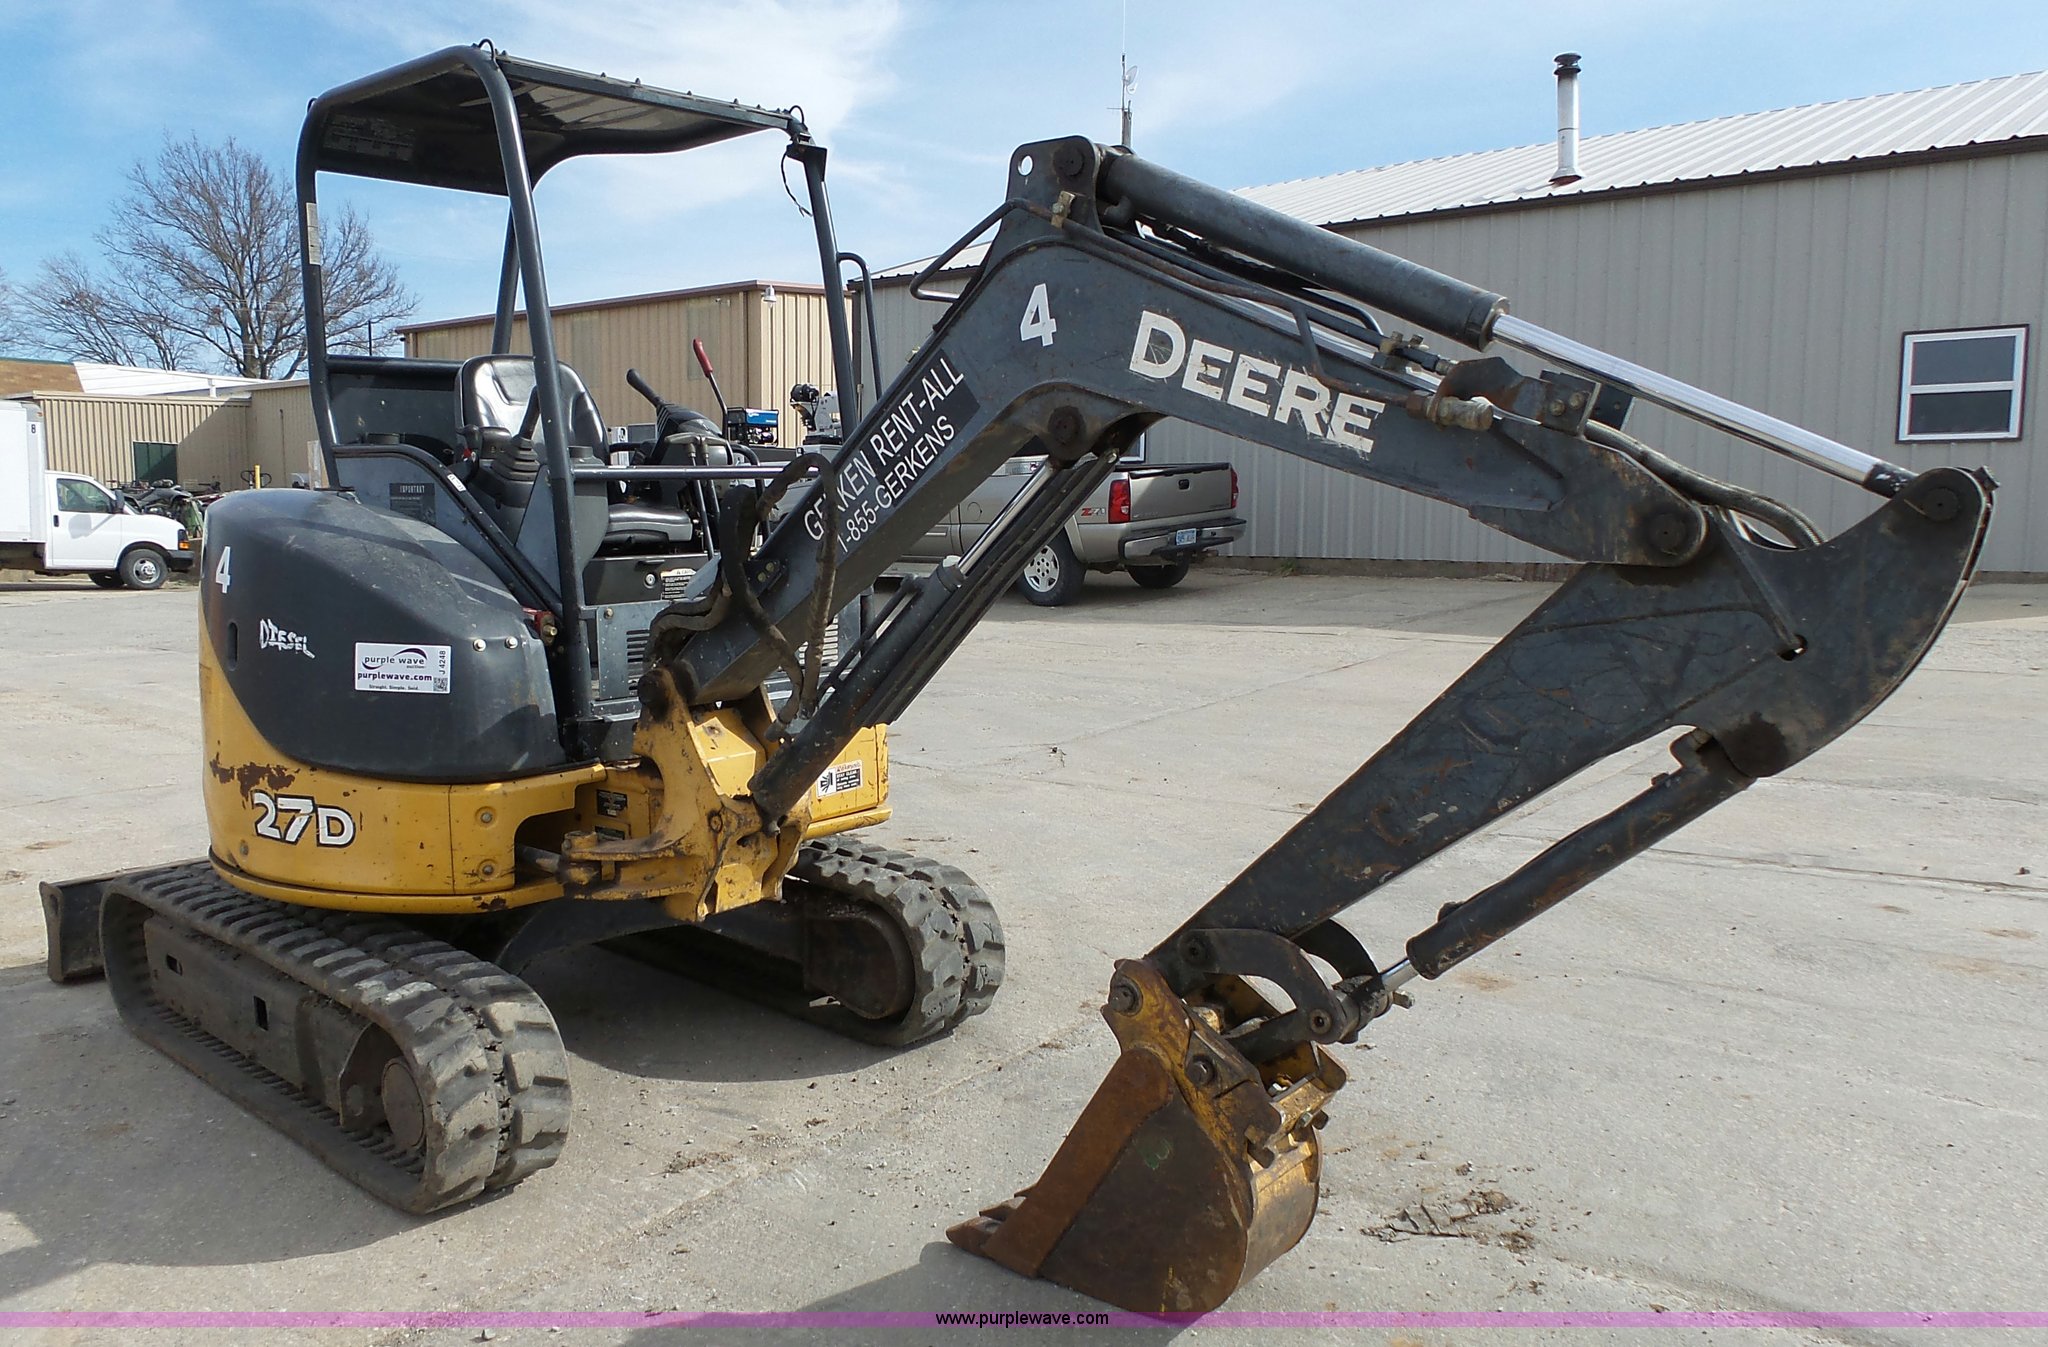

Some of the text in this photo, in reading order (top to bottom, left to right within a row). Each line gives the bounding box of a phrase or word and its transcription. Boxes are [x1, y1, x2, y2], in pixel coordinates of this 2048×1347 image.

[1020, 283, 1056, 347] 4
[1128, 311, 1385, 453] DEERE
[804, 358, 965, 541] GEKEN RENT-ALL
[837, 415, 955, 553] 1-855-GERKENS
[216, 546, 231, 593] 4
[358, 671, 432, 681] purplewave.com
[364, 656, 395, 664] purple
[251, 789, 356, 848] 27D
